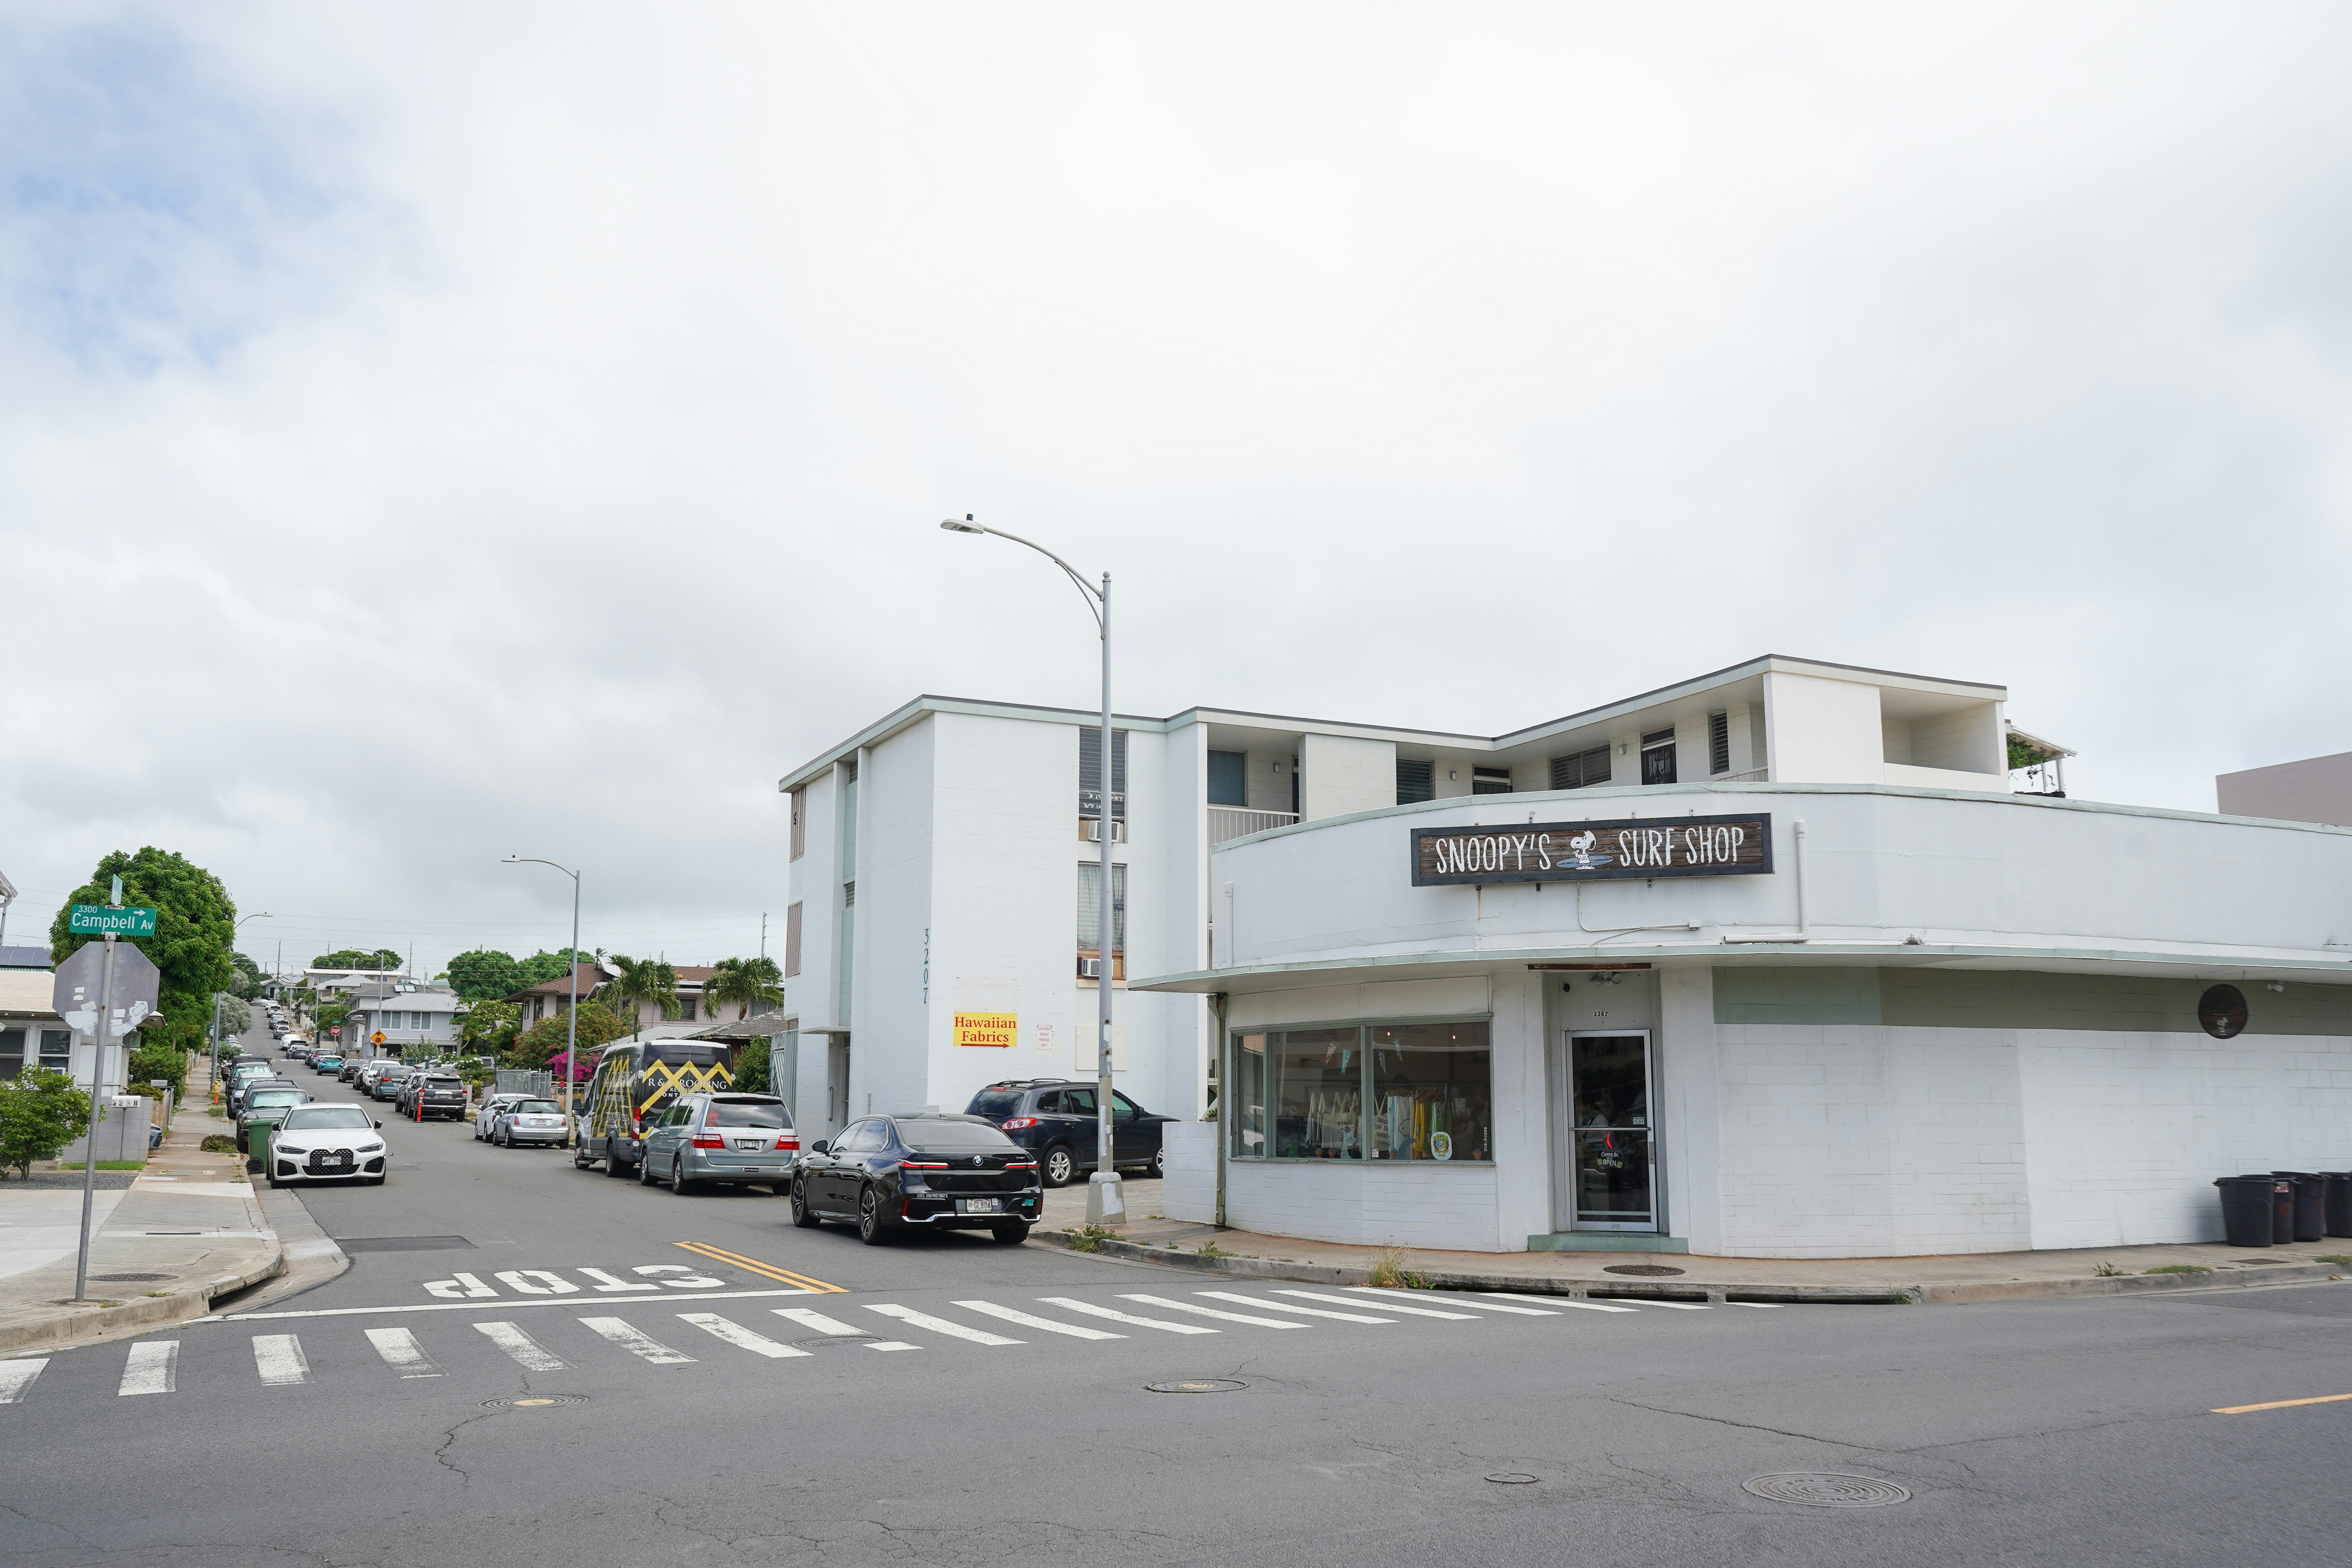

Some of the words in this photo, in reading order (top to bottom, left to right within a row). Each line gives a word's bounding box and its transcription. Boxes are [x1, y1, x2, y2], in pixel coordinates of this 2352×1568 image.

[1436, 833, 1551, 874] SNOOPY'S
[1618, 827, 1675, 867] SURF
[1685, 826, 1744, 864] SHOP
[72, 912, 135, 931] Campbell
[140, 919, 154, 930] Av
[954, 1016, 1017, 1028] Hawaiian
[962, 1031, 1009, 1042] Fabrics
[1590, 1046, 1629, 1057] PEAUTS
[648, 1078, 656, 1087] R
[658, 1078, 665, 1087] &
[668, 1078, 676, 1087] C
[679, 1079, 727, 1089] ROOFING
[422, 1264, 728, 1299] STOP
